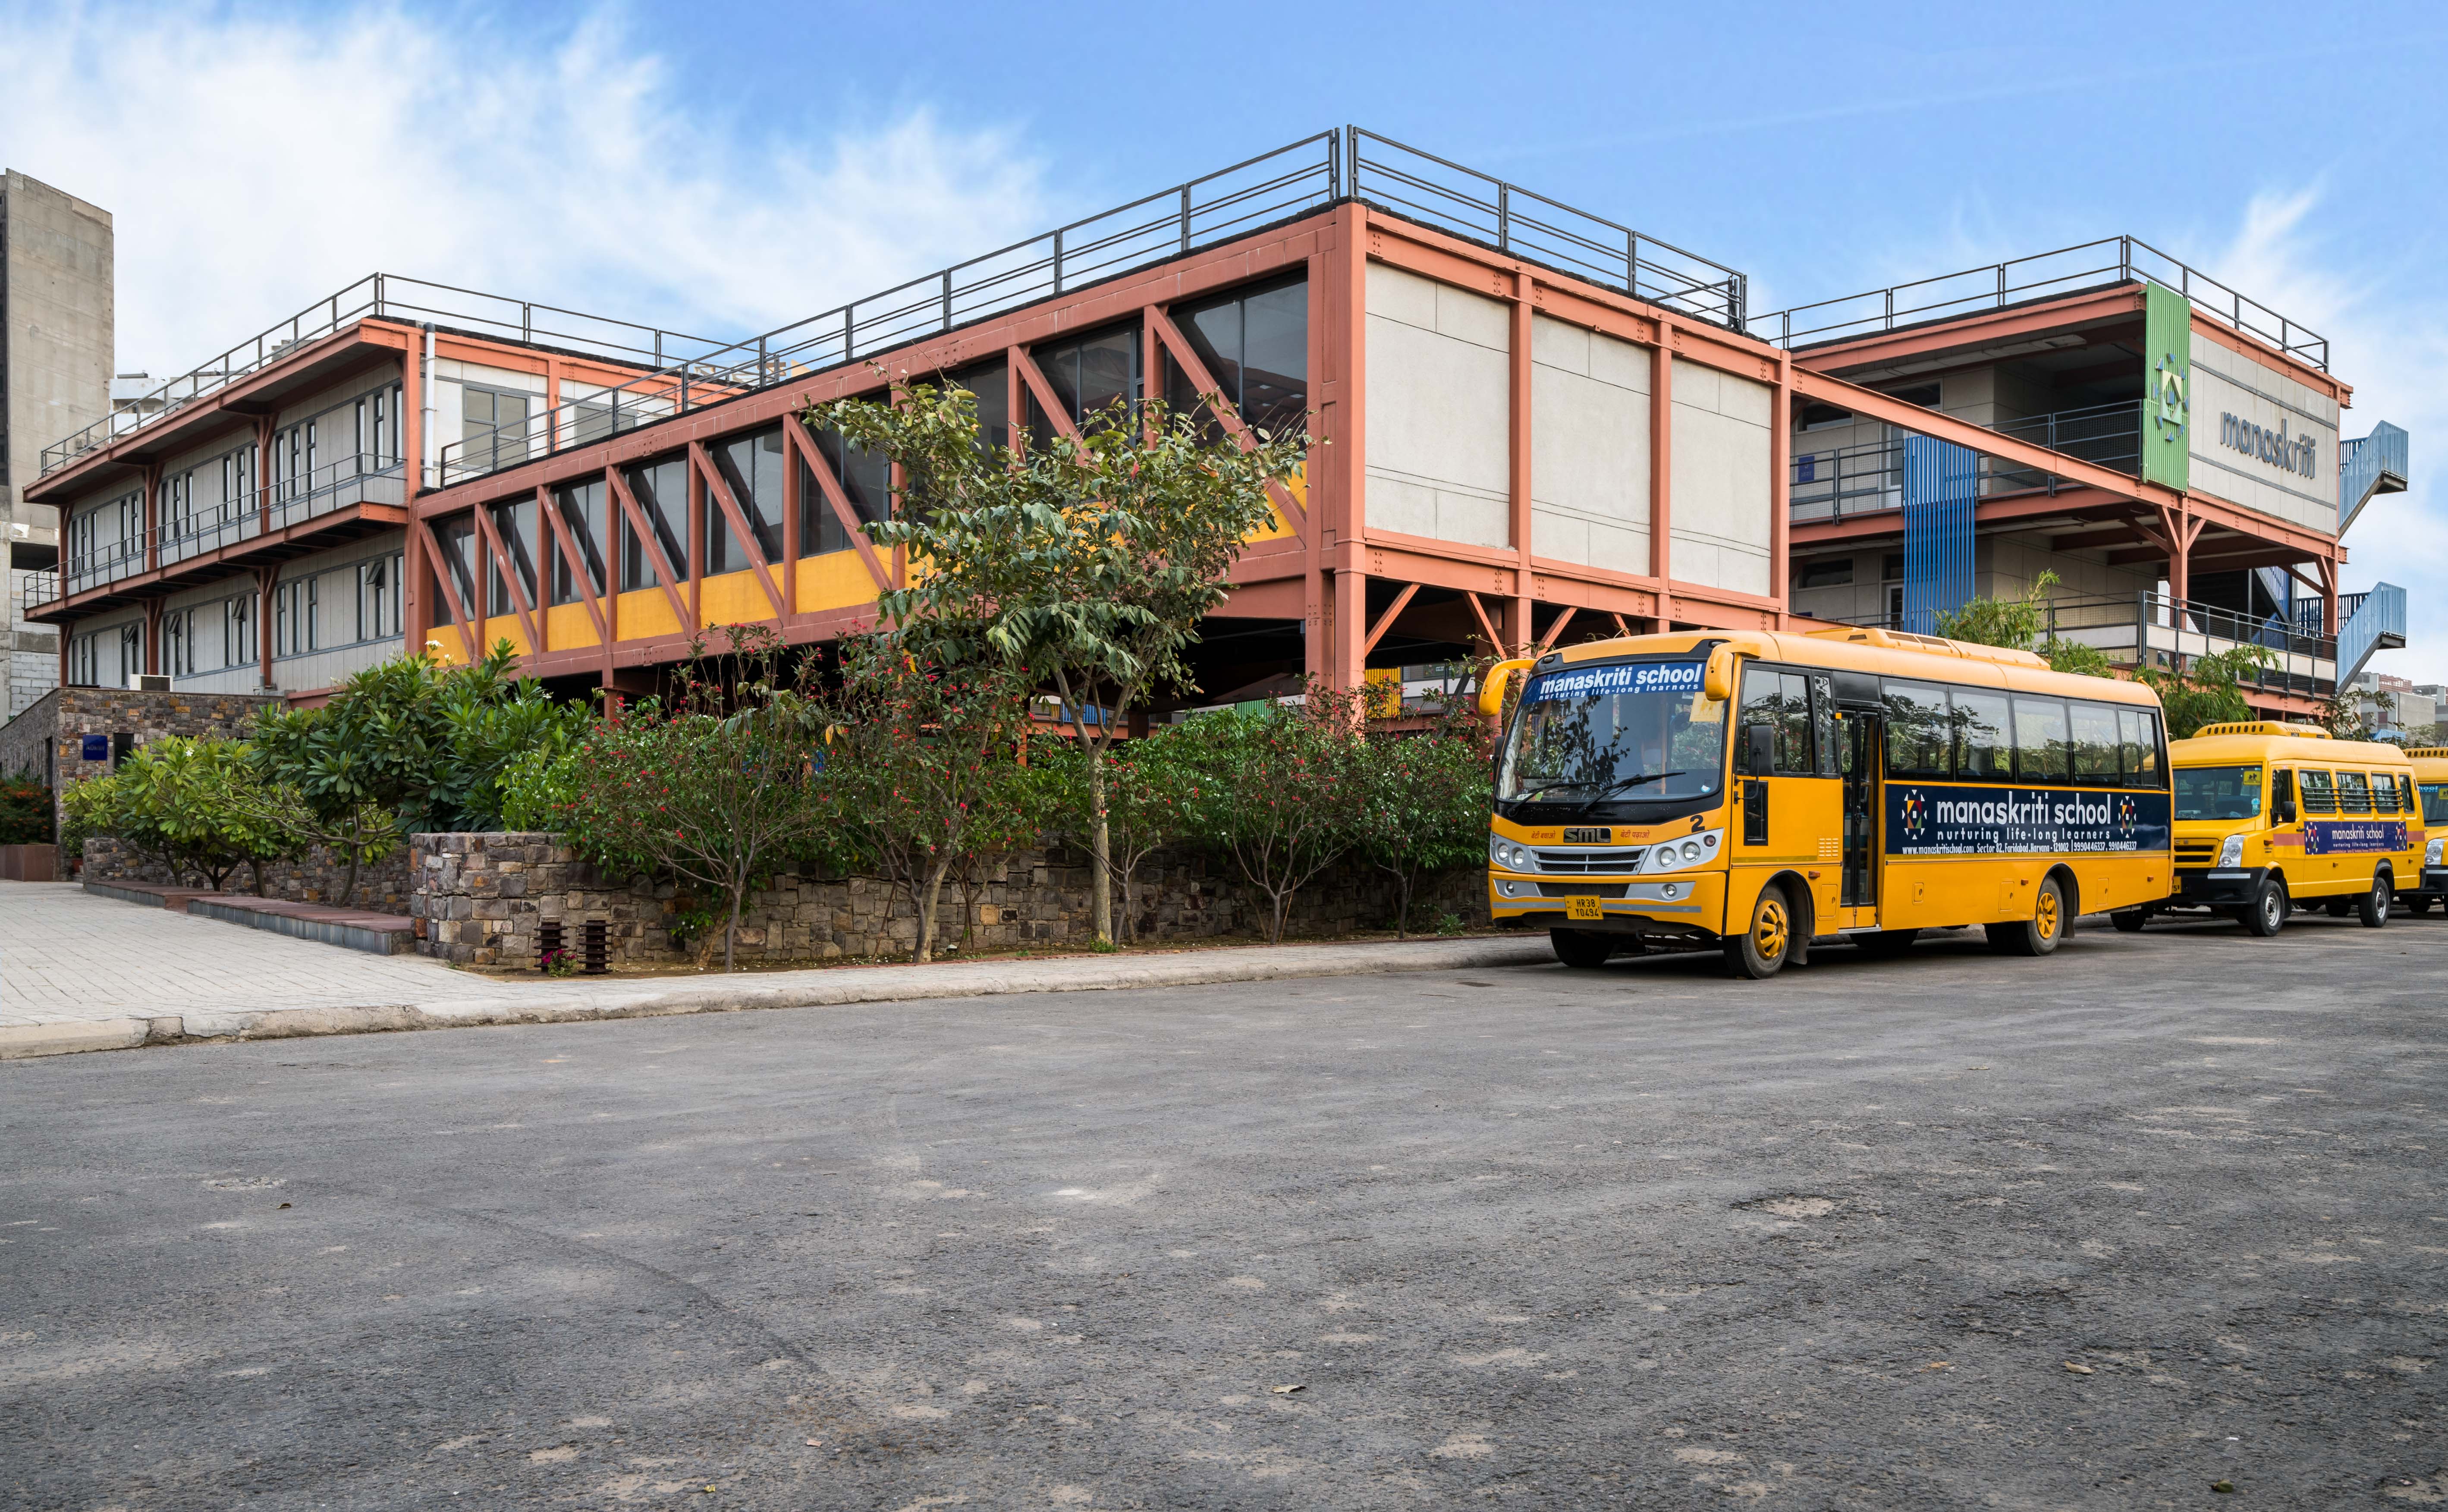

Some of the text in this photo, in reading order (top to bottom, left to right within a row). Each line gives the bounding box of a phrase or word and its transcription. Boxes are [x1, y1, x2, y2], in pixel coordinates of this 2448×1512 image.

[2220, 411, 2316, 479] manaskriti
[1540, 664, 1703, 695] manaskriti school
[1539, 690, 1586, 701] nurturing
[1591, 685, 1640, 696] life-long
[1937, 791, 2111, 825] manaskriti school
[1690, 815, 1705, 833] 2
[2332, 824, 2384, 840] manaskriti school
[1564, 828, 1611, 842] SML
[1620, 829, 1631, 838] बेटी
[1937, 827, 2110, 843] nurturing life-long learners
[1902, 843, 1974, 855] www.manaskritischool.com
[1977, 843, 1995, 853] Sector
[1576, 899, 1596, 908] HR38
[1575, 908, 1599, 917] Y0494
